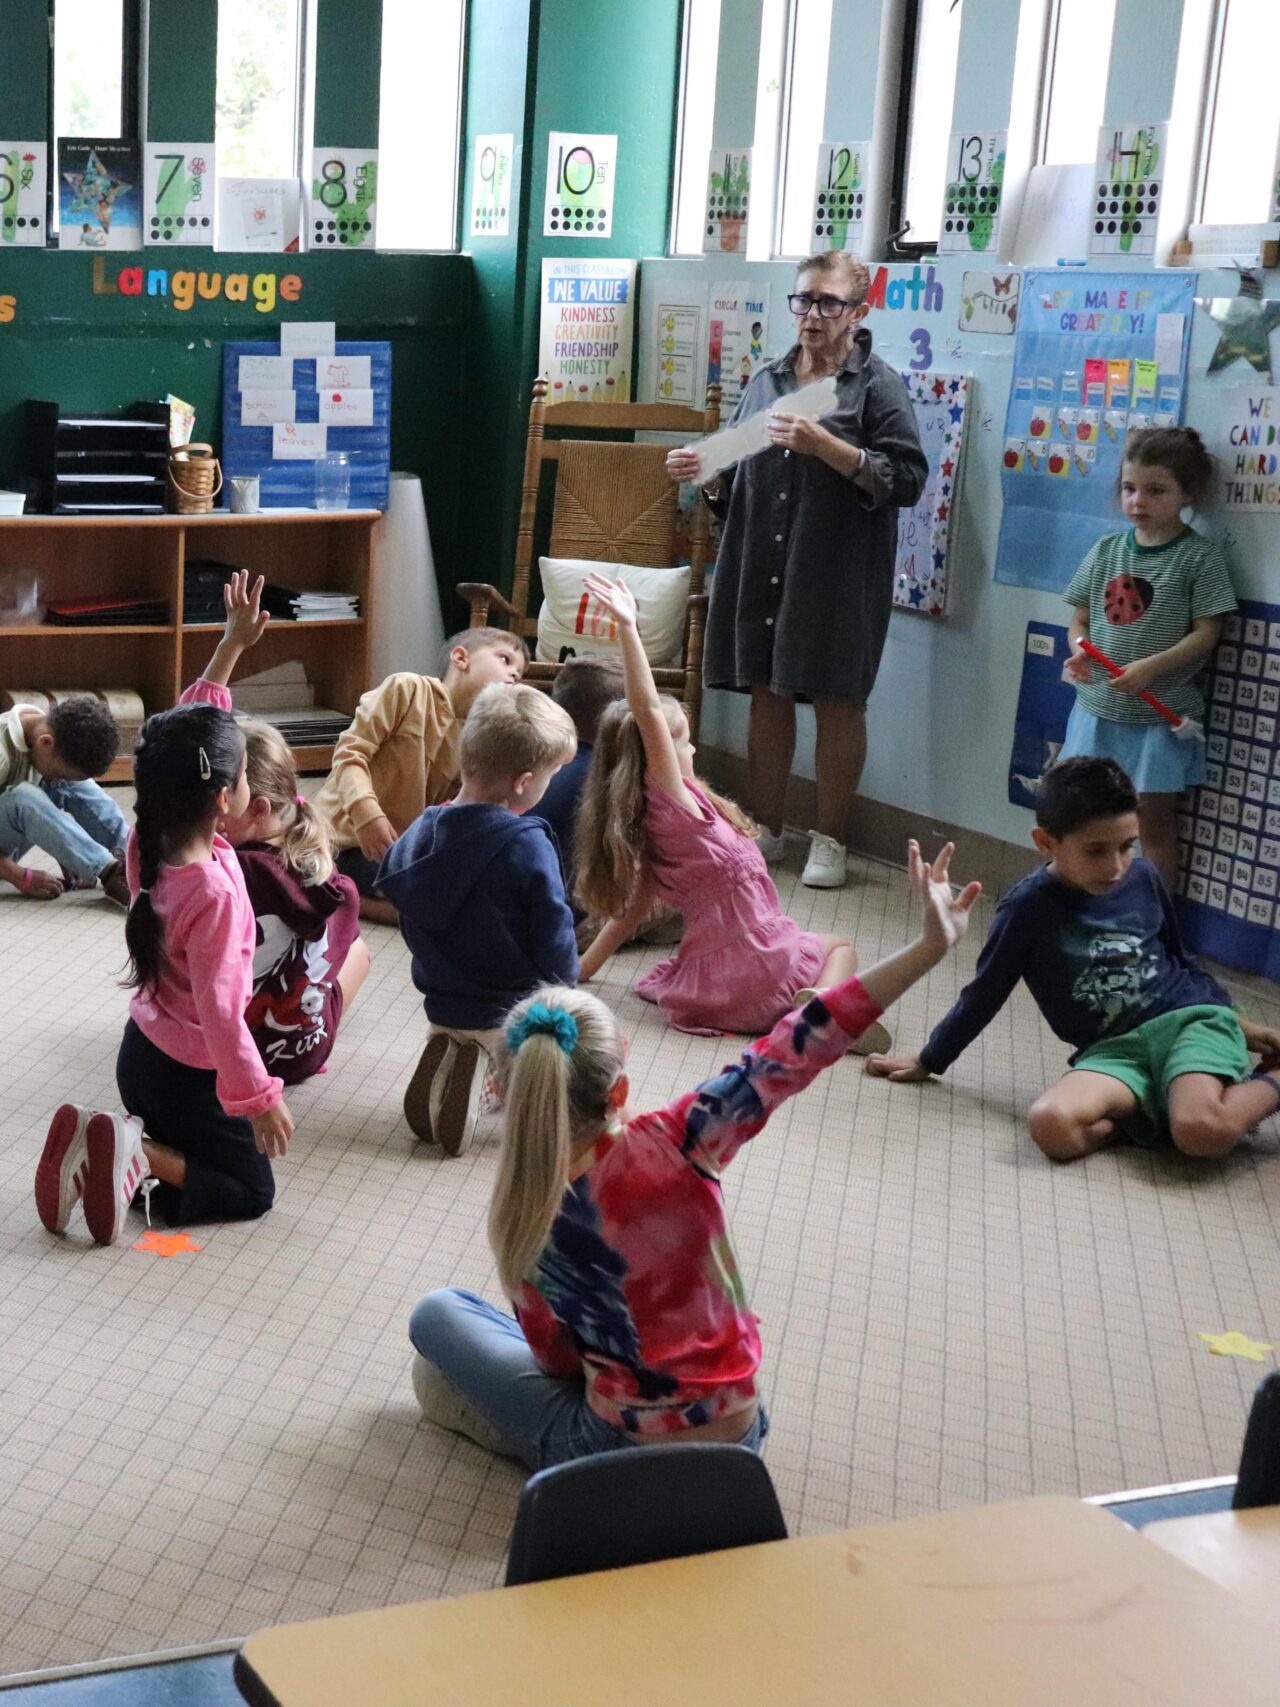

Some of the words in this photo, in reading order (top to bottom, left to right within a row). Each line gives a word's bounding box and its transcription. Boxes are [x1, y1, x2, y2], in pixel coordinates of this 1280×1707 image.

[957, 136, 982, 183] 13
[1111, 130, 1140, 179] 14
[154, 154, 185, 204] 7
[192, 157, 205, 202] Seven
[481, 146, 497, 194] 9
[556, 145, 595, 195] 10
[595, 160, 609, 185] Ten
[722, 153, 732, 193] 11
[828, 148, 851, 190] 12
[319, 160, 347, 208] 8
[92, 256, 304, 313] Language
[553, 279, 576, 301] WE
[580, 280, 621, 301] VALUE
[866, 266, 944, 313] Math
[560, 306, 616, 323] KINDNESS
[714, 299, 739, 311] CIRCLE
[745, 302, 764, 313] TIME
[554, 323, 619, 341] CREATIVITY
[555, 342, 619, 358] FRIENDSHIP
[909, 327, 933, 371] 3
[560, 359, 611, 375] HONESTY
[324, 401, 358, 413] apples
[1248, 397, 1272, 418] WE
[1230, 424, 1261, 446] CAN
[1235, 453, 1278, 476] HARD
[1252, 624, 1259, 636] 3
[1247, 655, 1258, 668] 13
[1270, 661, 1280, 673] 14
[1217, 682, 1230, 695] 22
[1241, 687, 1254, 700] 23
[1263, 690, 1276, 703] 24
[1214, 711, 1227, 724] 32
[1237, 716, 1250, 729] 33
[1259, 721, 1272, 734] 34
[1233, 748, 1246, 760] 43
[1253, 752, 1266, 765] 44
[1228, 775, 1240, 788] 53
[1250, 781, 1262, 792] 54
[1202, 797, 1215, 810] 62
[1223, 803, 1235, 816] 63
[1200, 827, 1211, 840] 72
[1222, 832, 1233, 846] 73
[1241, 839, 1253, 852] 74
[1264, 845, 1278, 858] 75
[1196, 855, 1208, 868] 82
[1216, 861, 1227, 874] 83
[1236, 868, 1248, 881] 84
[1257, 874, 1272, 888] 85
[1192, 881, 1204, 895] 92
[1212, 888, 1223, 901] 93
[1252, 904, 1267, 918] 95
